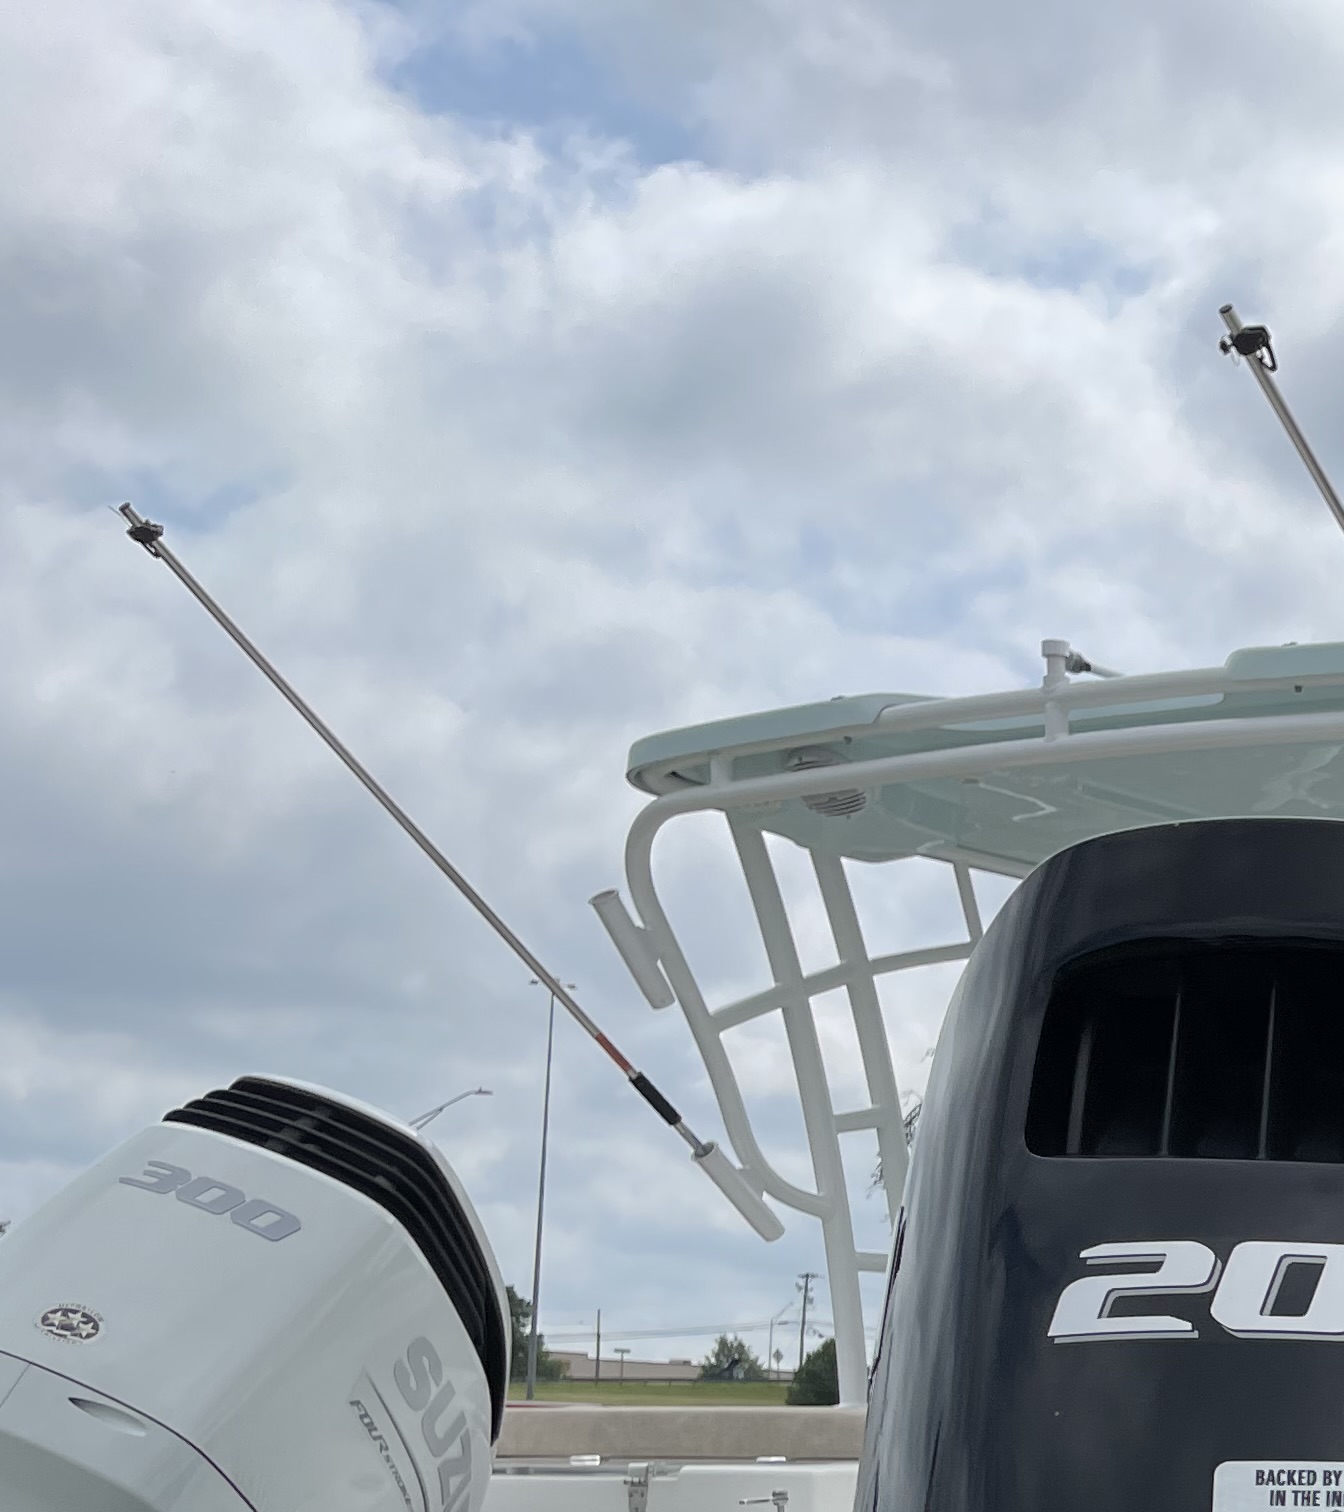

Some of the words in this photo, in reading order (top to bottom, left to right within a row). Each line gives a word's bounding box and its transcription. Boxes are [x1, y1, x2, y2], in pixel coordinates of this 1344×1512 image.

[118, 1160, 302, 1242] 300
[1255, 1469, 1317, 1486] BACKED
[1323, 1470, 1342, 1487] BY
[1269, 1490, 1286, 1507] IN
[1292, 1490, 1320, 1507] THE
